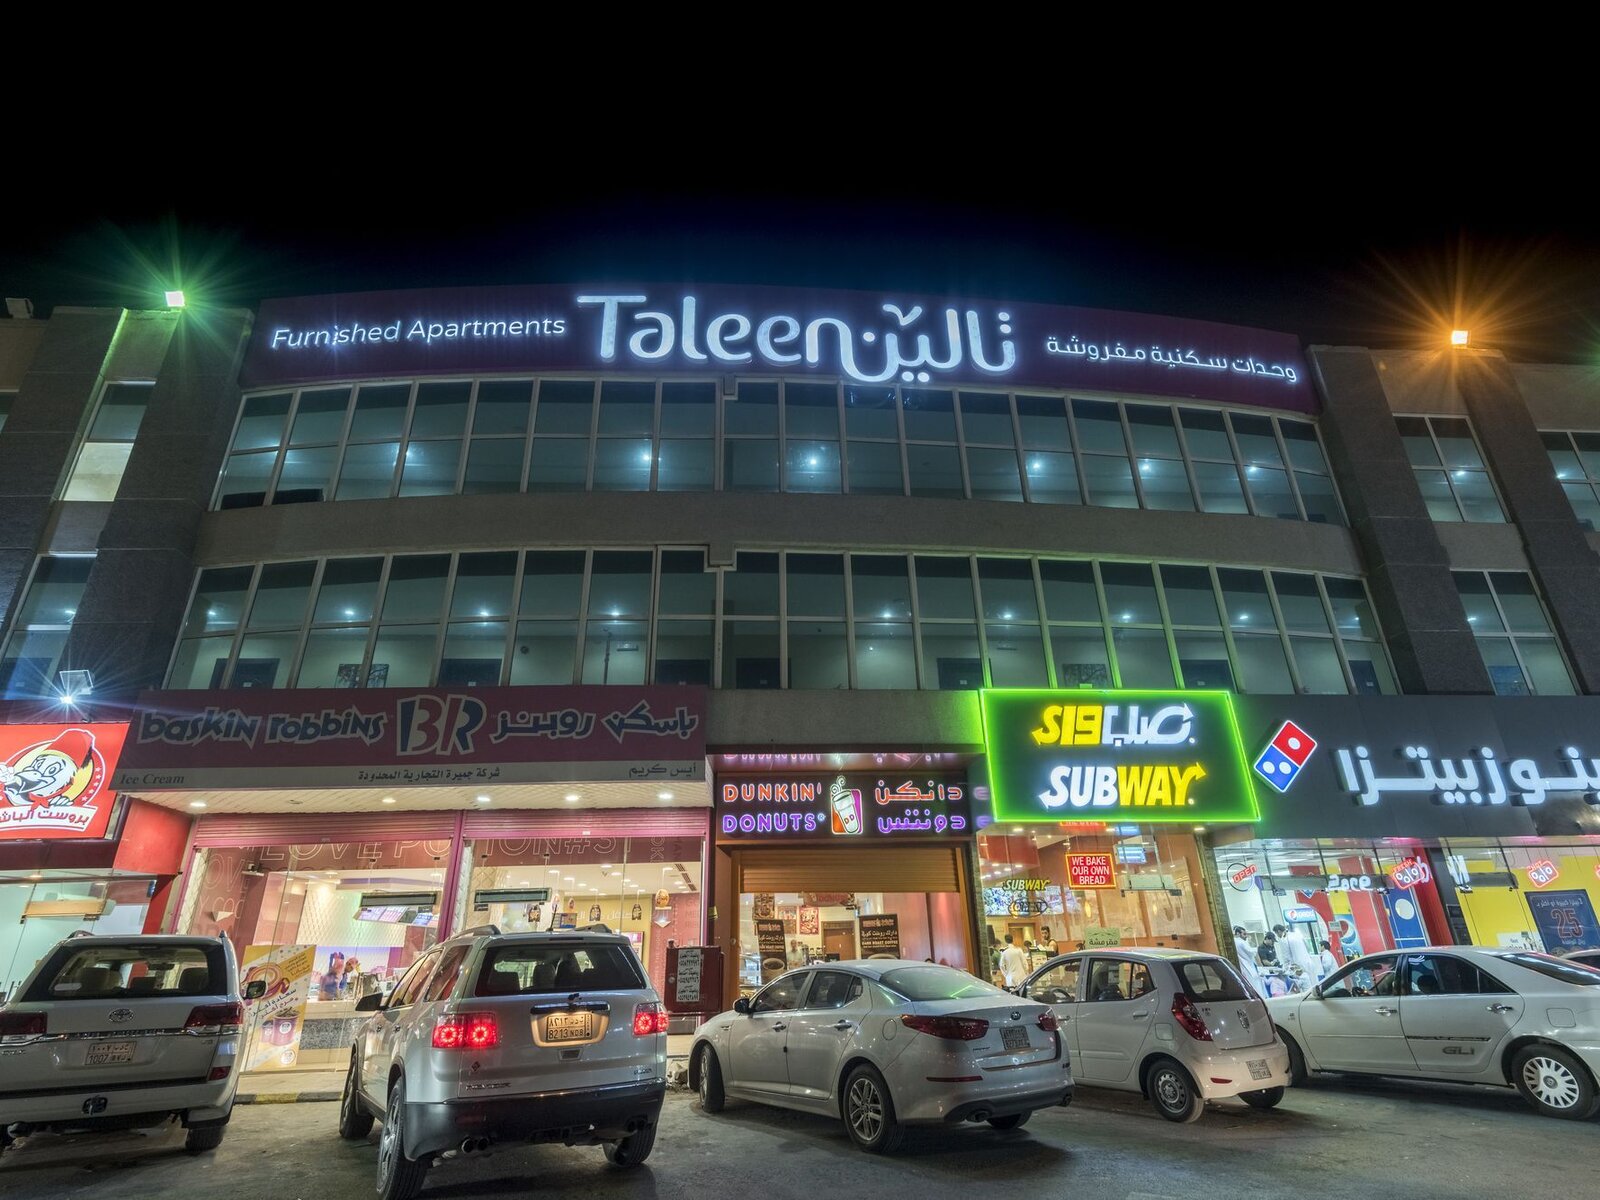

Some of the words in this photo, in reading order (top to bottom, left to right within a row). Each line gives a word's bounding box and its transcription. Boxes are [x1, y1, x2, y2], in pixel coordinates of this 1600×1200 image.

[271, 319, 401, 350] Furnished
[406, 318, 567, 345] Apartments
[576, 294, 862, 376] Taleen
[1046, 334, 1146, 363] مفروشة
[1151, 344, 1228, 371] سكنية
[1233, 357, 1298, 384] وحدات
[396, 694, 487, 756] BR
[604, 700, 698, 743] باسكن
[120, 774, 139, 785] Ice
[142, 773, 185, 785] Cream
[358, 770, 400, 781] المحدودة
[403, 769, 443, 783] التجارية
[476, 767, 500, 780] شركة
[628, 763, 668, 778] كريم
[723, 782, 823, 803] DUNKIN'
[875, 780, 963, 805] دانكن
[1038, 762, 1207, 810] SUBWAY
[1072, 856, 1084, 866] WE
[1086, 856, 1106, 866] BAKE
[1072, 866, 1089, 875] OUR
[1091, 866, 1110, 875] OWN
[1079, 876, 1106, 885] BREAD
[1234, 865, 1257, 882] OPEN
[1003, 879, 1051, 891] SUBWAY
[1551, 908, 1584, 943] 25
[548, 1028, 569, 1039] 8213
